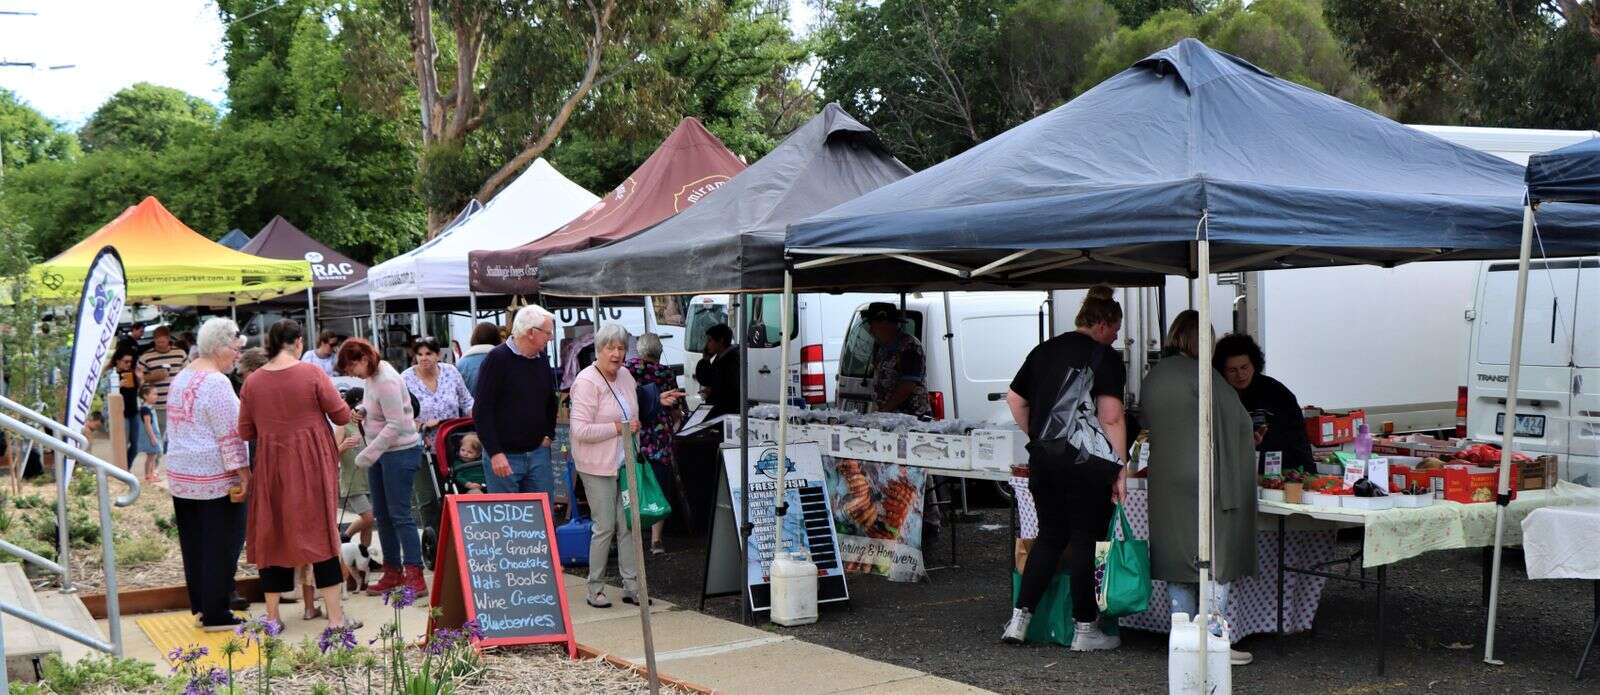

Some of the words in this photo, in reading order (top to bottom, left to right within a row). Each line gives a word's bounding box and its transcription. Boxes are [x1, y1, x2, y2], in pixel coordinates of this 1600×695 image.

[466, 504, 534, 524] INSIDE
[463, 526, 501, 547] Soap
[501, 525, 546, 539] Shrooms
[467, 544, 502, 561] Fudge
[505, 540, 548, 555] Granola
[468, 558, 497, 573] Birds
[499, 557, 549, 570] Chocolate
[472, 575, 501, 590] Hats
[505, 572, 548, 586] Books
[474, 594, 508, 610] Wine
[510, 591, 556, 606] Cheese
[476, 613, 556, 632] Blueberries
